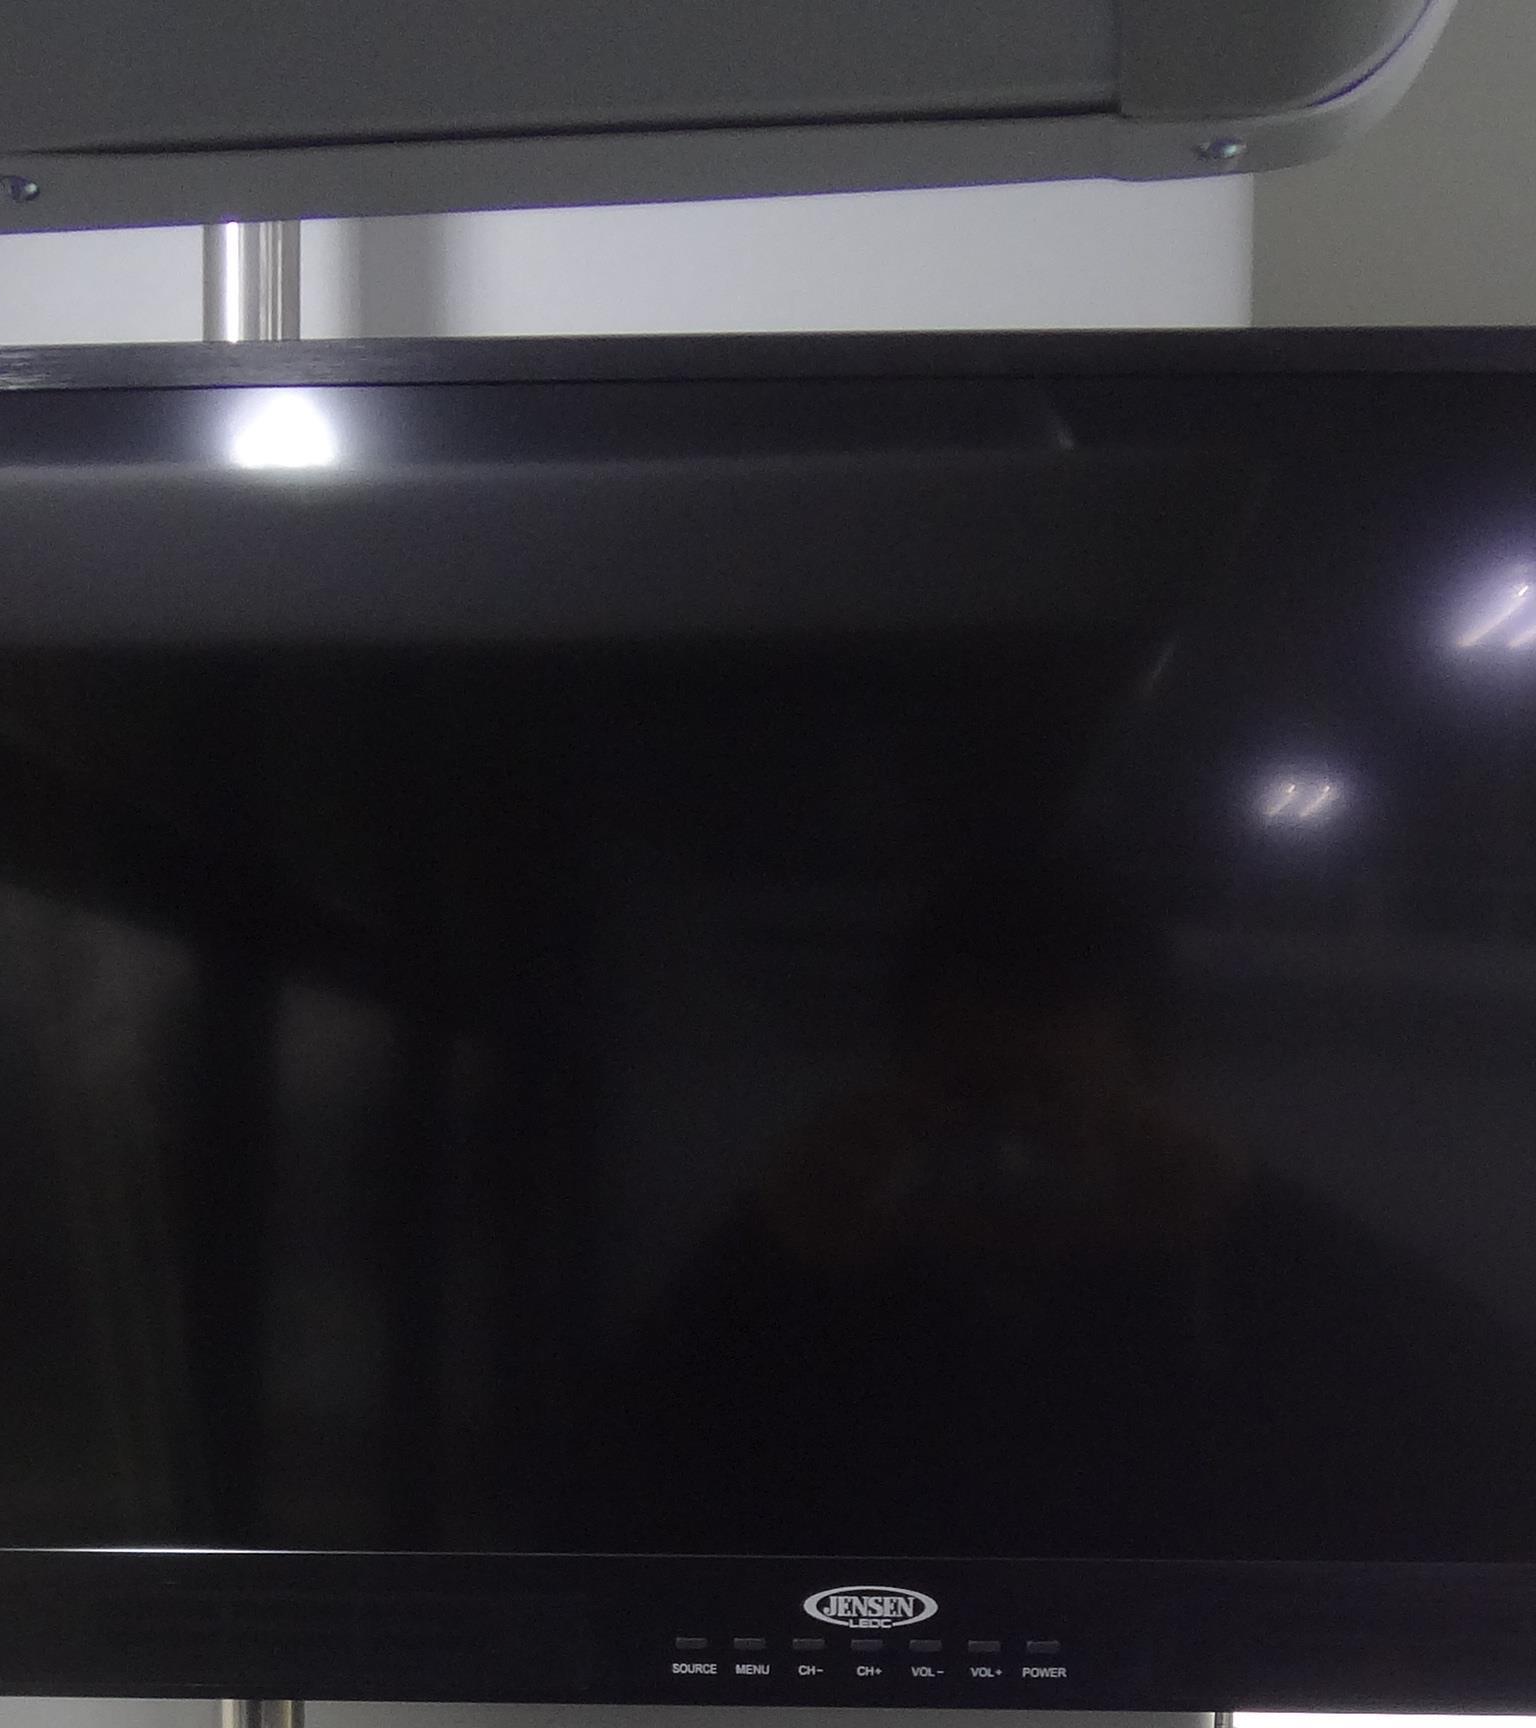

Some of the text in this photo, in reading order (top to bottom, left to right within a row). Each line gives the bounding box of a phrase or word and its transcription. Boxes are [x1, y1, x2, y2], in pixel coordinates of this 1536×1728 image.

[823, 1595, 916, 1617] JENSEN
[672, 1663, 718, 1675] SOURCE
[735, 1664, 771, 1676] MENU
[856, 1666, 882, 1677] CH+
[971, 1667, 1003, 1678] VOL+
[1022, 1667, 1067, 1679] POWER
